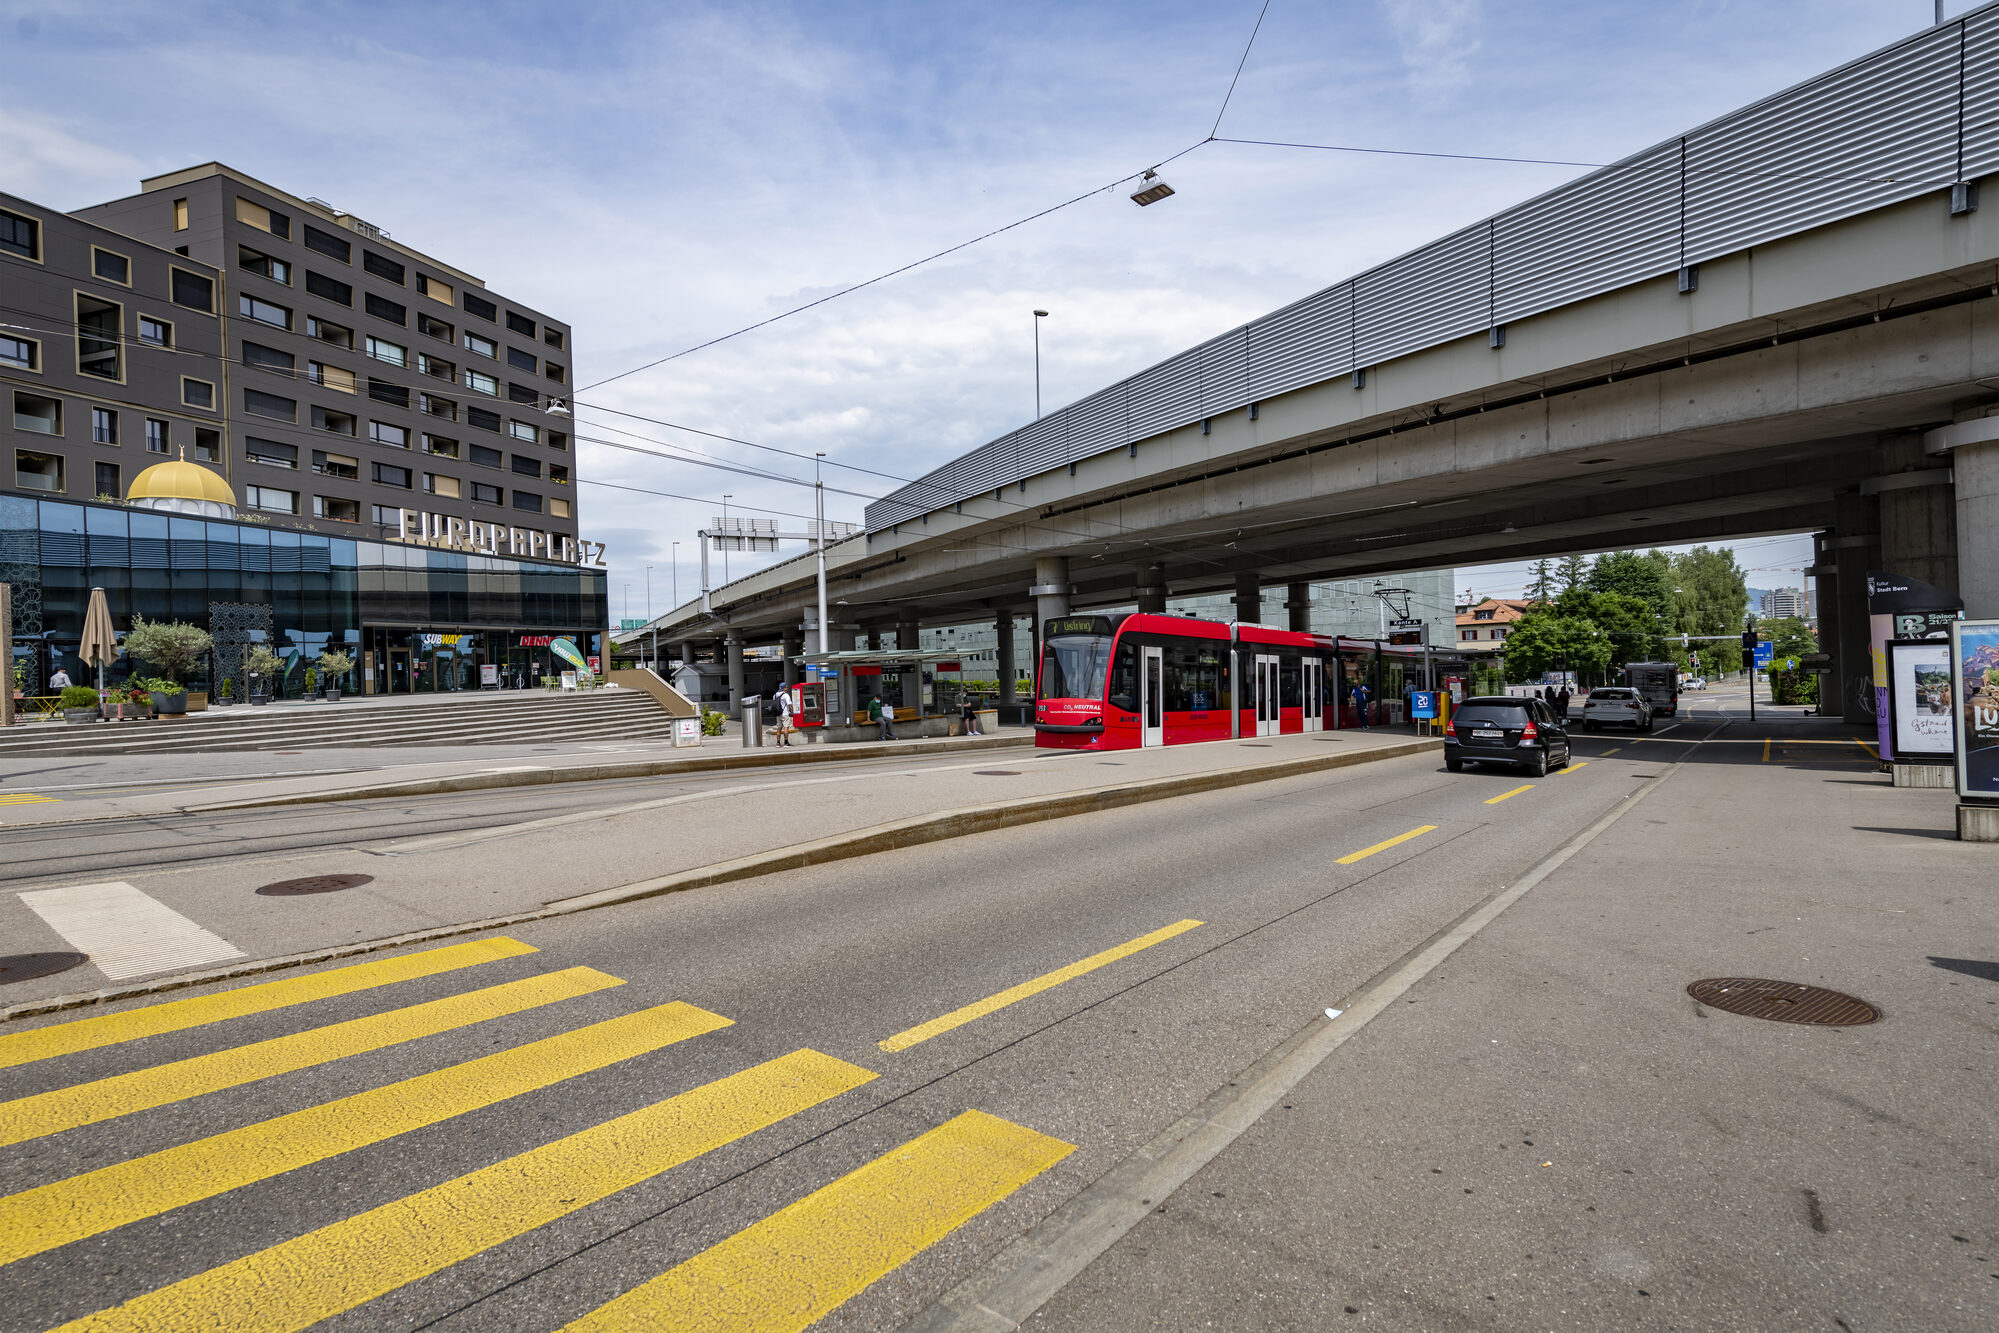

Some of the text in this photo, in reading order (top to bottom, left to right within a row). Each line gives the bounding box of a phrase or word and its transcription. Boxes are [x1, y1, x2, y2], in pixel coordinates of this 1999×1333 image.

[400, 508, 606, 566] EUROPAPLATZ
[1050, 622, 1057, 633] 7
[423, 633, 463, 645] SUBWAY
[520, 635, 557, 646] DENN
[1418, 695, 1428, 706] 20
